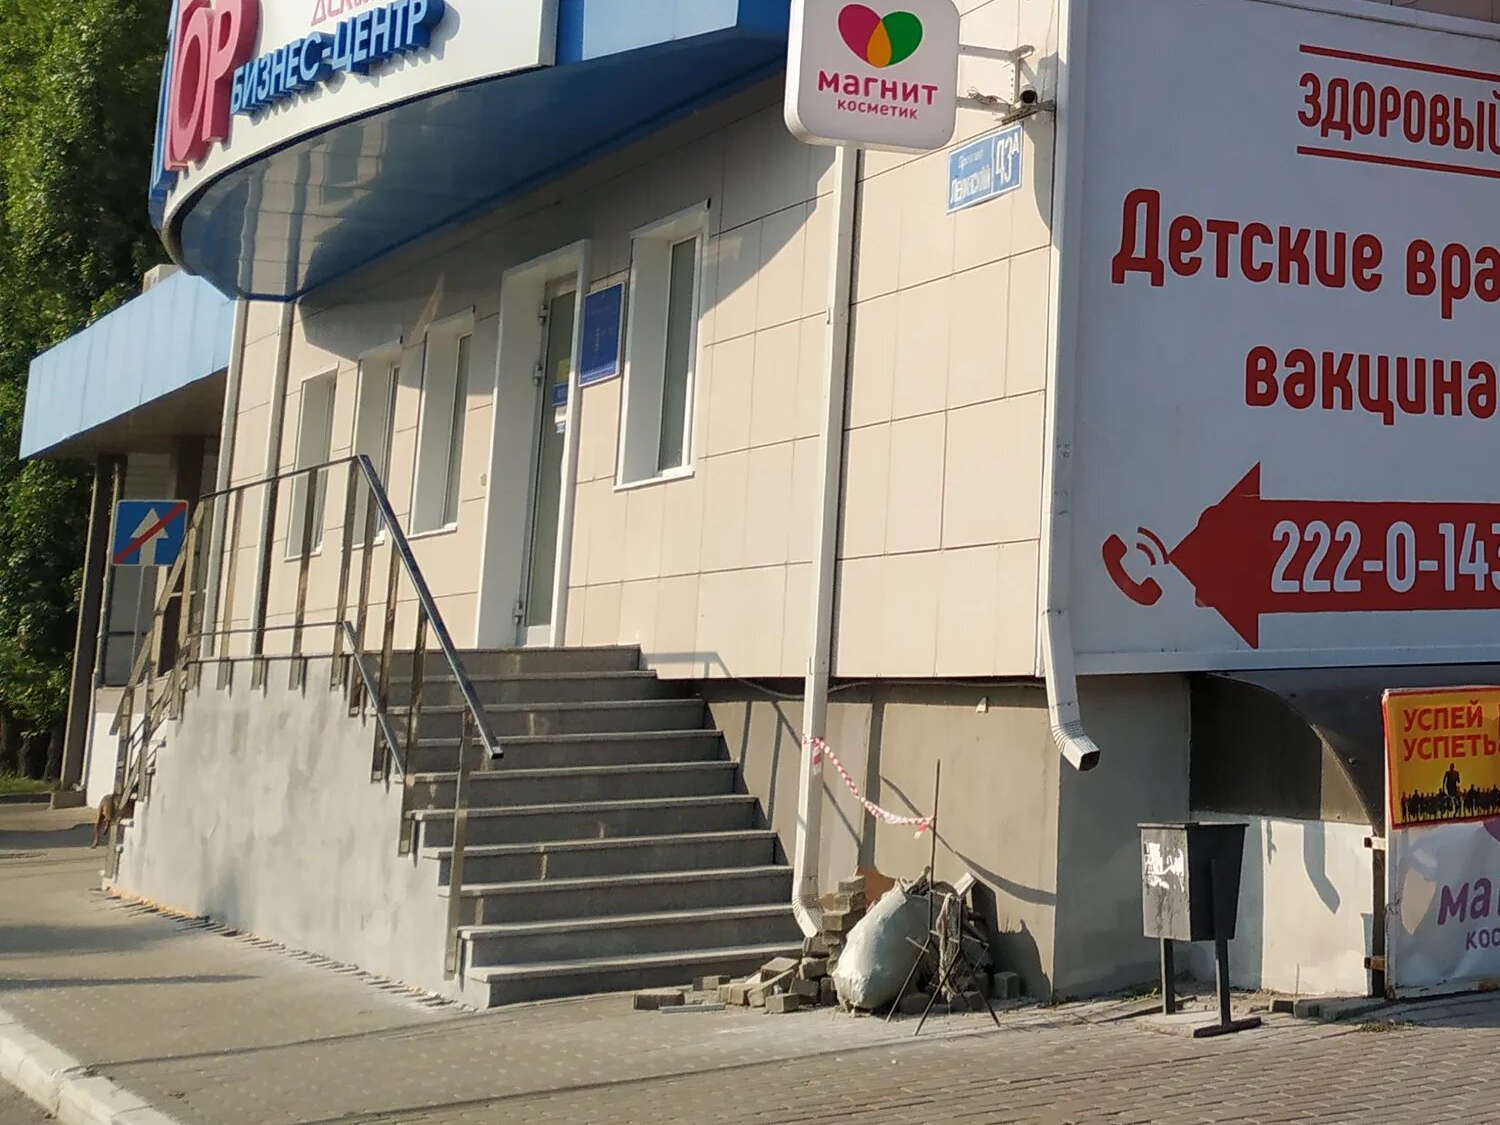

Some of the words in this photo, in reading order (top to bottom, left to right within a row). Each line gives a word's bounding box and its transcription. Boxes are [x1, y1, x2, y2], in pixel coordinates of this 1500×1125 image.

[836, 98, 918, 120] косметик
[1111, 187, 1384, 293] Детские
[1403, 698, 1484, 732] УСПЕЙ
